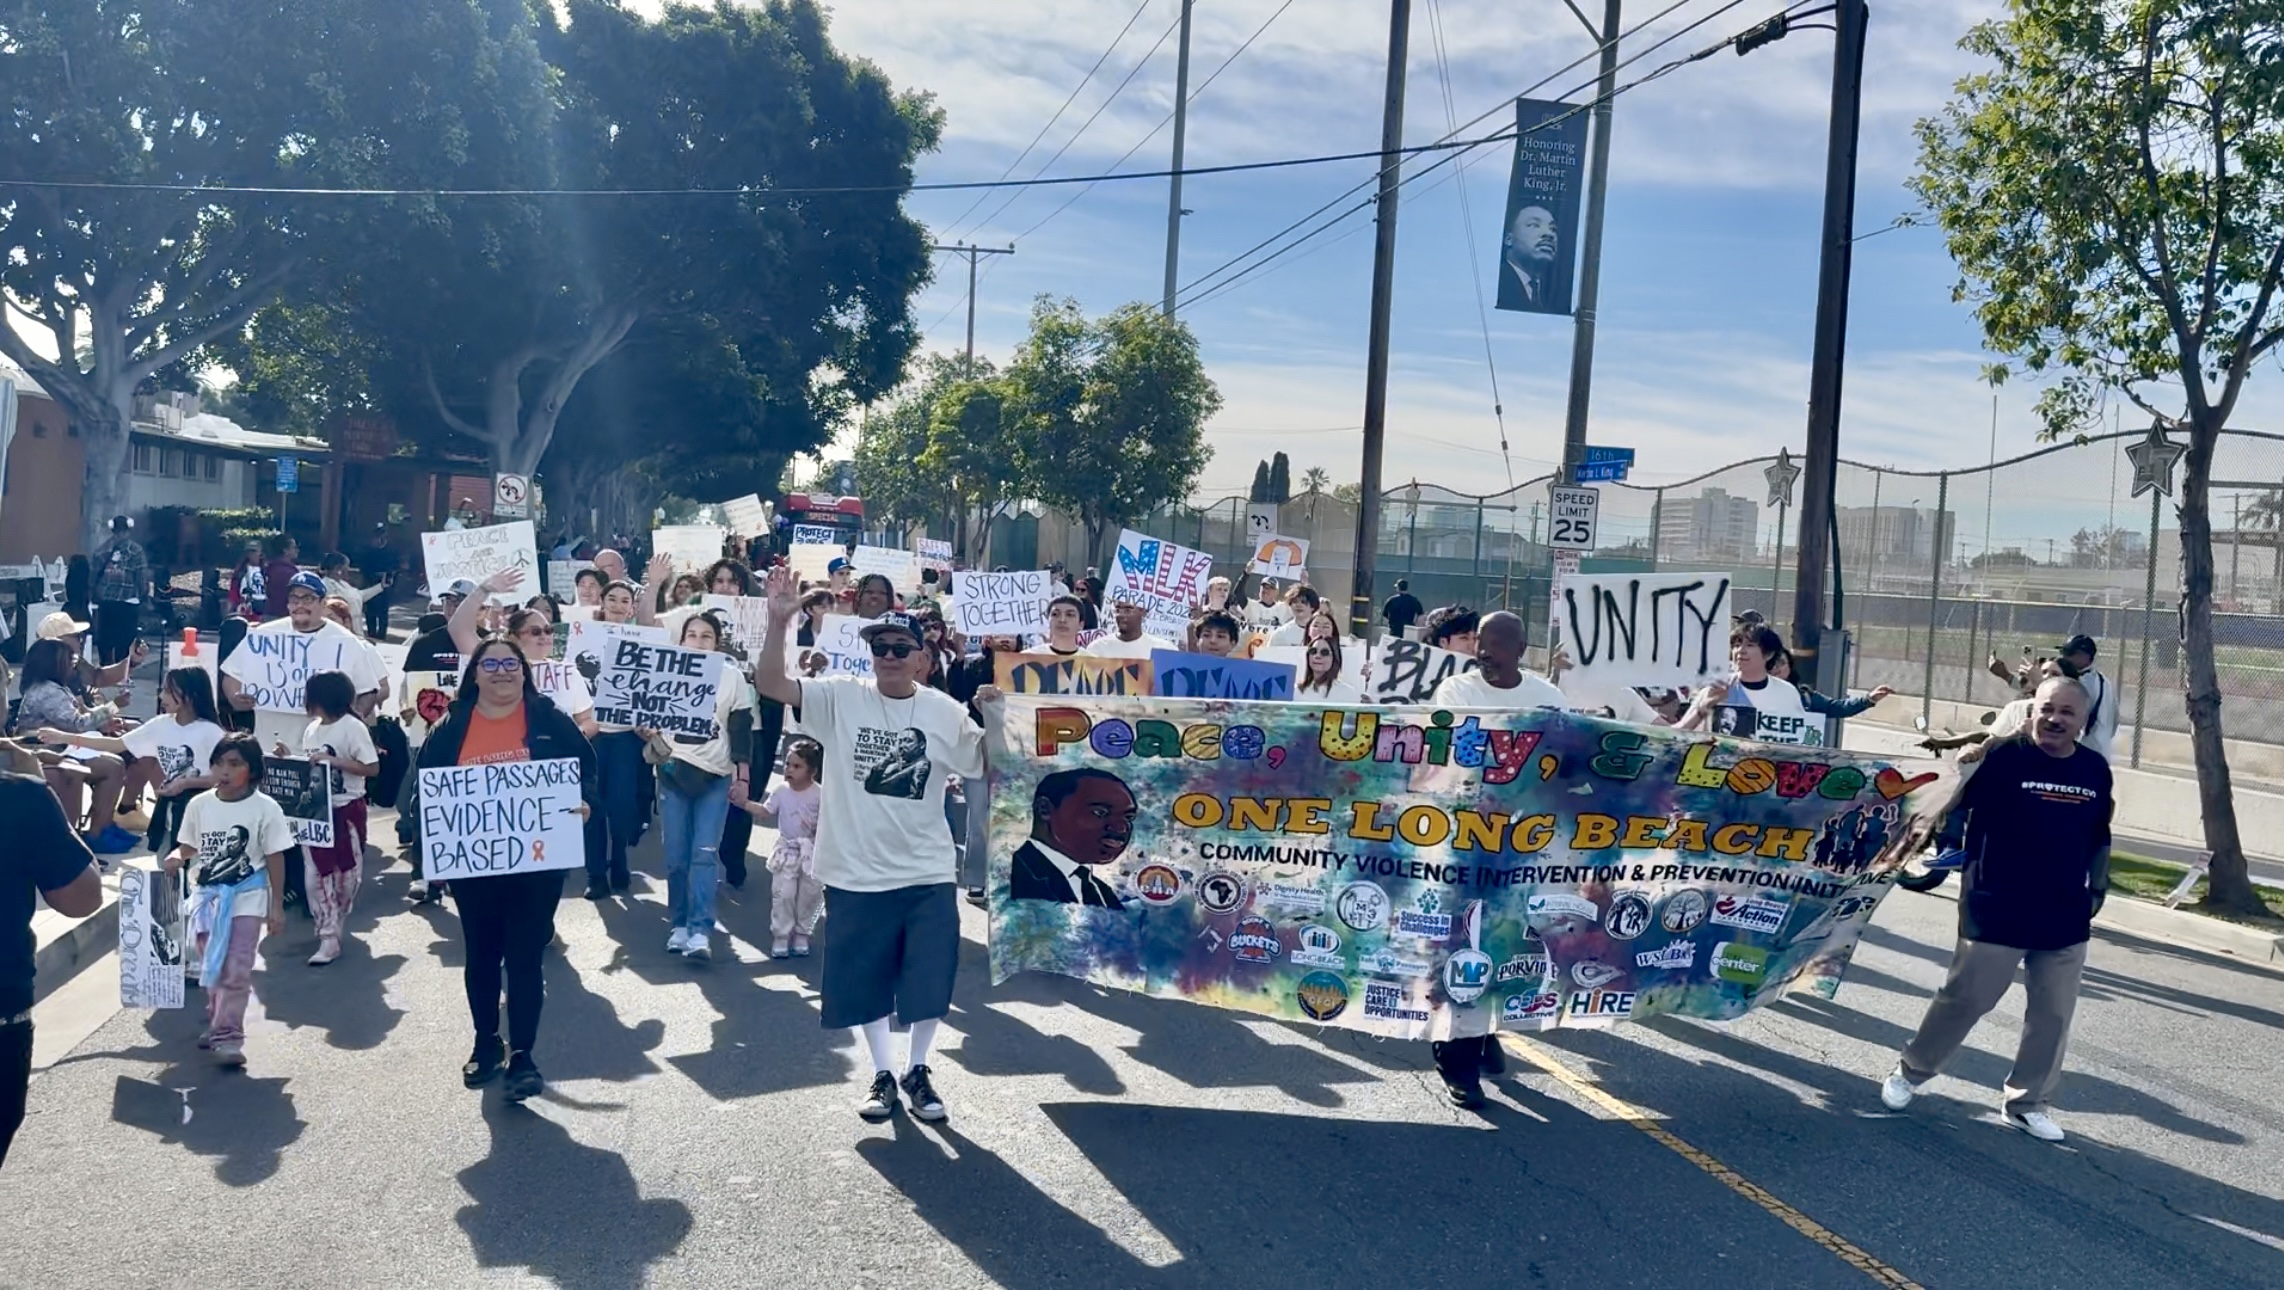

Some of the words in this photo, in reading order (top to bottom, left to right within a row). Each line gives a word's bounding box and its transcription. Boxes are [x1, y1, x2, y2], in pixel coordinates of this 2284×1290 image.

[1523, 137, 1576, 155] Honoring
[1520, 151, 1537, 162] Dr.
[1539, 152, 1577, 166] Martin
[1528, 164, 1566, 179] Luther
[1523, 177, 1553, 192] King,
[1555, 180, 1567, 192] Jr.
[1591, 449, 1615, 461] 16th
[1555, 493, 1595, 506] SPEED
[808, 511, 839, 522] SPECIAL
[1558, 506, 1589, 518] LIMIT
[446, 526, 510, 551] PEACE
[796, 526, 833, 539] PROTECT
[1553, 519, 1590, 543] 25
[964, 573, 1041, 600] STRONG
[1117, 540, 1213, 612] MLK
[1112, 584, 1165, 615] PARADE
[1166, 602, 1194, 619] 202
[956, 598, 1049, 632] TOGETHER
[1564, 578, 1730, 674] UNITY
[247, 633, 315, 669] UNITY
[614, 639, 652, 669] BE
[655, 648, 707, 677] THE
[533, 662, 576, 692] TAFF
[243, 681, 306, 709] POWE
[603, 669, 716, 708] change
[631, 691, 672, 713] NOT
[595, 706, 633, 726] THE
[635, 711, 713, 737] PROBLEM
[1756, 710, 1805, 735] KEEP
[857, 733, 870, 743] TO
[873, 736, 896, 747] STAY
[1035, 706, 1287, 770] Peace,
[1319, 709, 1558, 785] Unity,
[1589, 730, 1654, 781] &
[1676, 742, 1867, 802] Love
[422, 767, 478, 798] SAFE
[485, 760, 582, 796] PASSAGES
[307, 821, 332, 844] LBC
[1172, 791, 1334, 835] ONE
[1347, 800, 1557, 855] LONG
[1569, 812, 1815, 864] BEACH
[431, 835, 524, 875] BASED
[1199, 841, 1348, 874] COMMUNITY
[1354, 854, 1468, 886] VIOLENCE
[1475, 864, 1626, 888] INTERVENTION
[1630, 864, 1645, 882] &
[1650, 863, 1791, 890] PREVENTION
[1274, 884, 1300, 895] Dignity
[1300, 887, 1325, 896] Health
[1401, 910, 1440, 924] Success
[1440, 914, 1450, 926] in
[1727, 903, 1780, 925] Action
[1400, 922, 1450, 937] Challenges
[1230, 934, 1280, 954] BUCKETS
[1365, 983, 1401, 999] JUSTICE
[1365, 994, 1388, 1007] CARE
[1363, 1004, 1430, 1022] OPPORTUNITIES
[1503, 1011, 1555, 1021] COLLECTIVE
